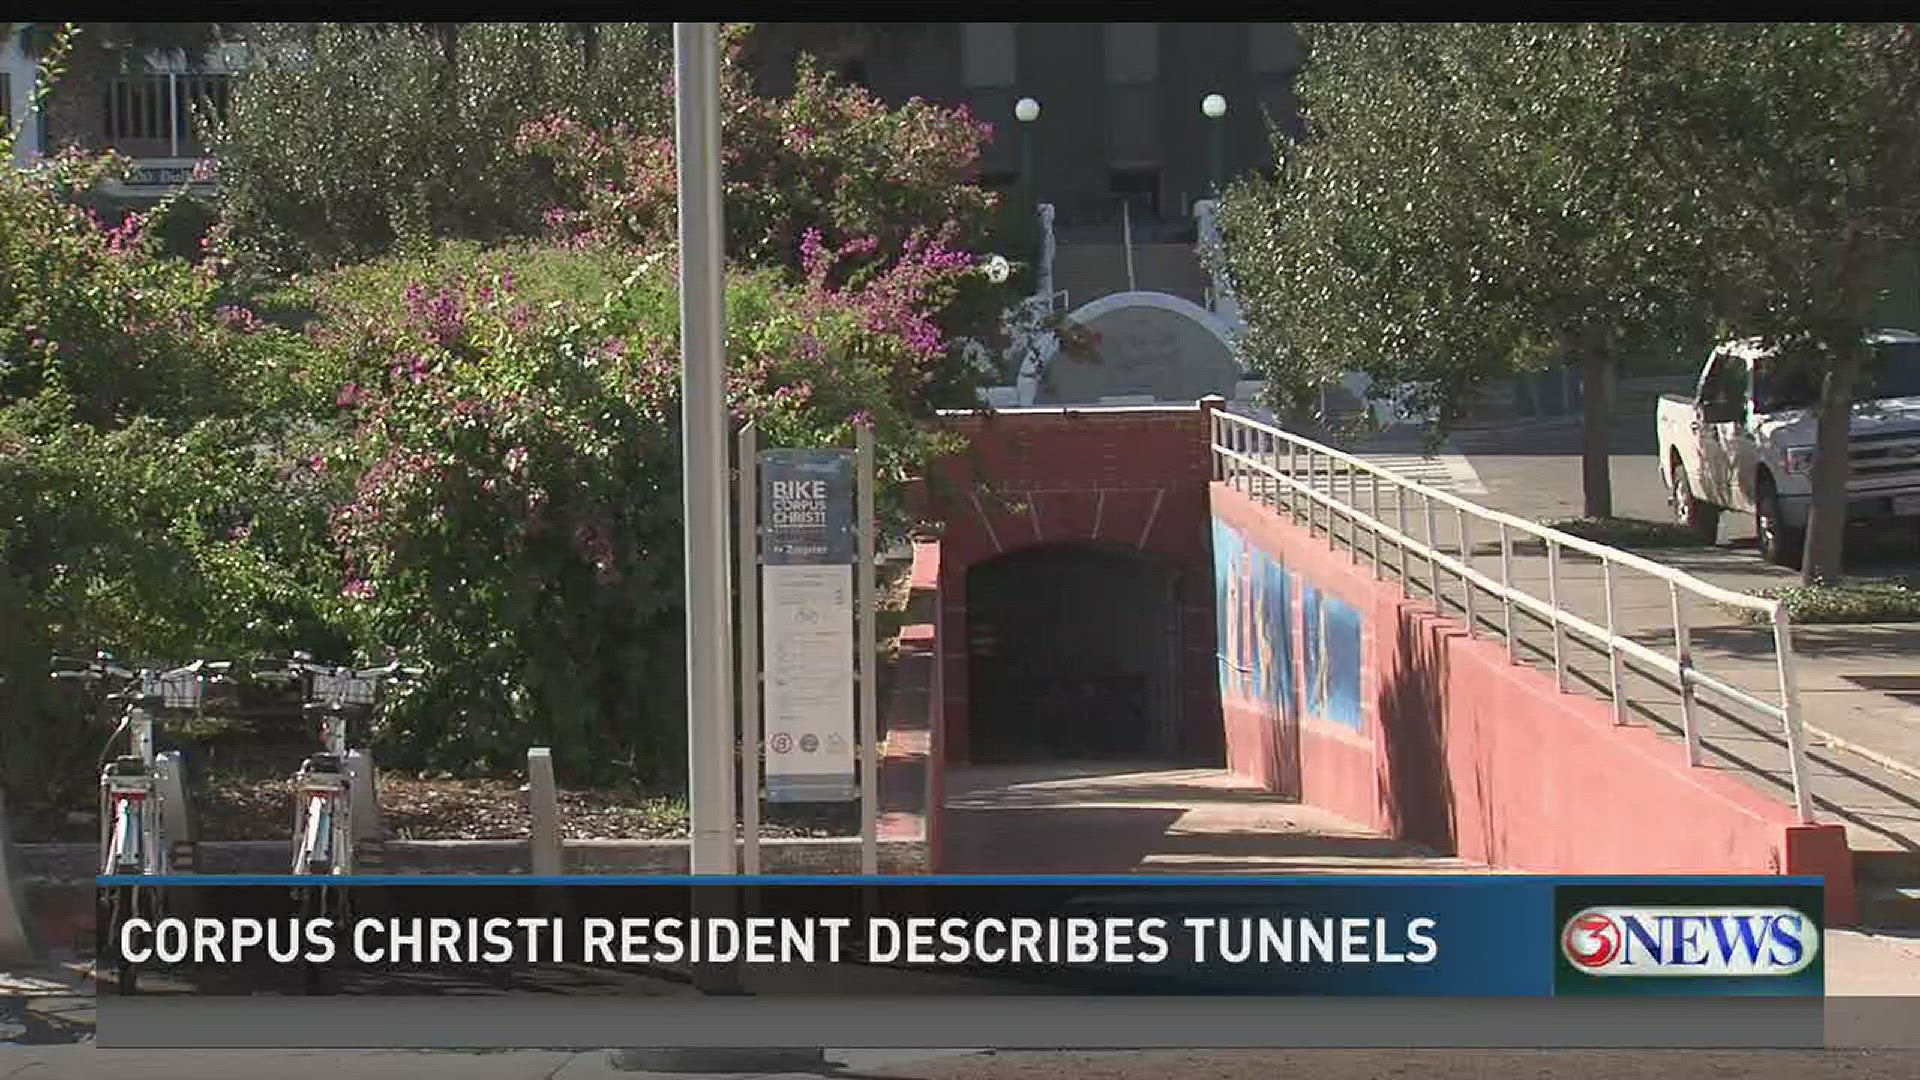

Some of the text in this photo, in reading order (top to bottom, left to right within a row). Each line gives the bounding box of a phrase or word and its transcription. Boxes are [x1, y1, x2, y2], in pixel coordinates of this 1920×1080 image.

[773, 480, 828, 499] BIKE
[772, 499, 828, 512] CORPUS
[772, 511, 827, 525] CHRISTI
